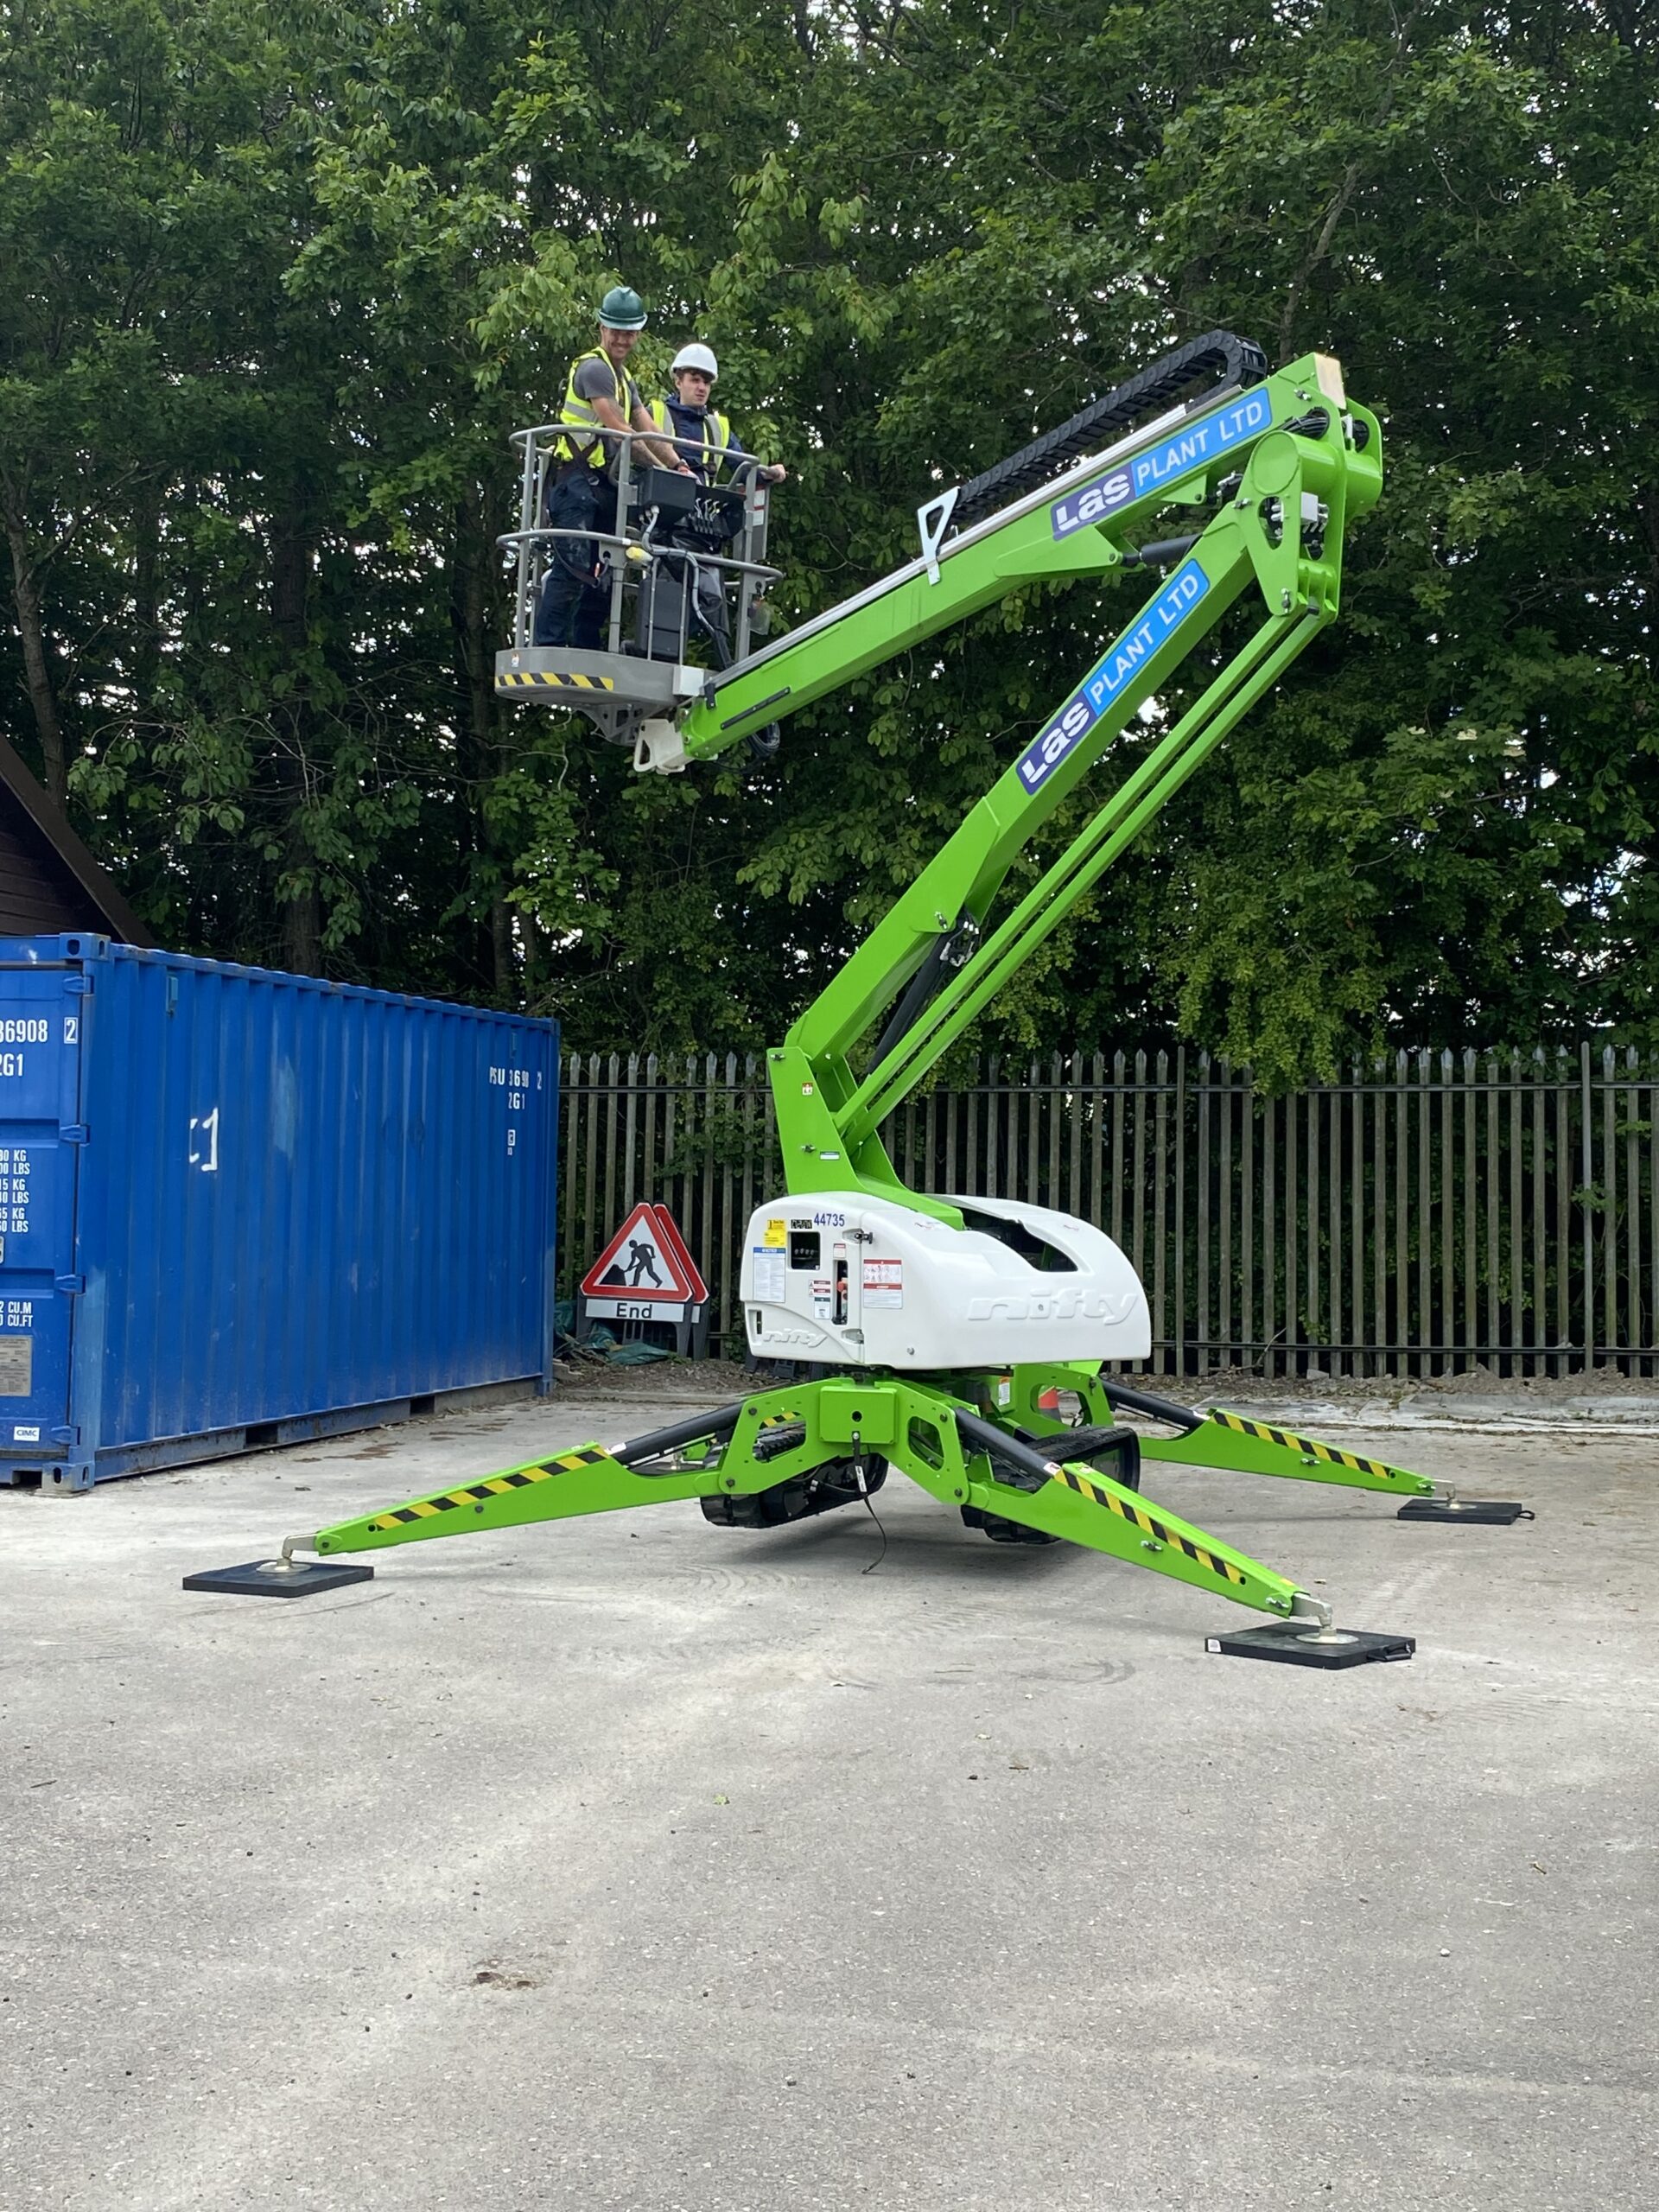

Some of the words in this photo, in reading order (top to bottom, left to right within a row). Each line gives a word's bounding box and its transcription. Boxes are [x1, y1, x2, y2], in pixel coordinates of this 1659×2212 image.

[1136, 428, 1209, 487] PLANT
[1218, 400, 1262, 442] LTD
[1090, 622, 1154, 705] PLANT
[1158, 573, 1198, 626] LTD
[66, 1019, 76, 1042] 2
[0, 1052, 24, 1077] G1
[508, 1091, 525, 1110] 2G1
[13, 1149, 27, 1162] KG
[13, 1162, 30, 1175] LBS
[12, 1178, 26, 1191] KG
[12, 1191, 29, 1204] LBS
[12, 1207, 25, 1219] KG
[813, 1213, 845, 1227] 44735
[11, 1220, 29, 1233] LBS
[8, 1301, 32, 1314] CU.M
[615, 1301, 653, 1319] End
[967, 1286, 1139, 1325] nifty
[8, 1314, 34, 1328] CU.FT
